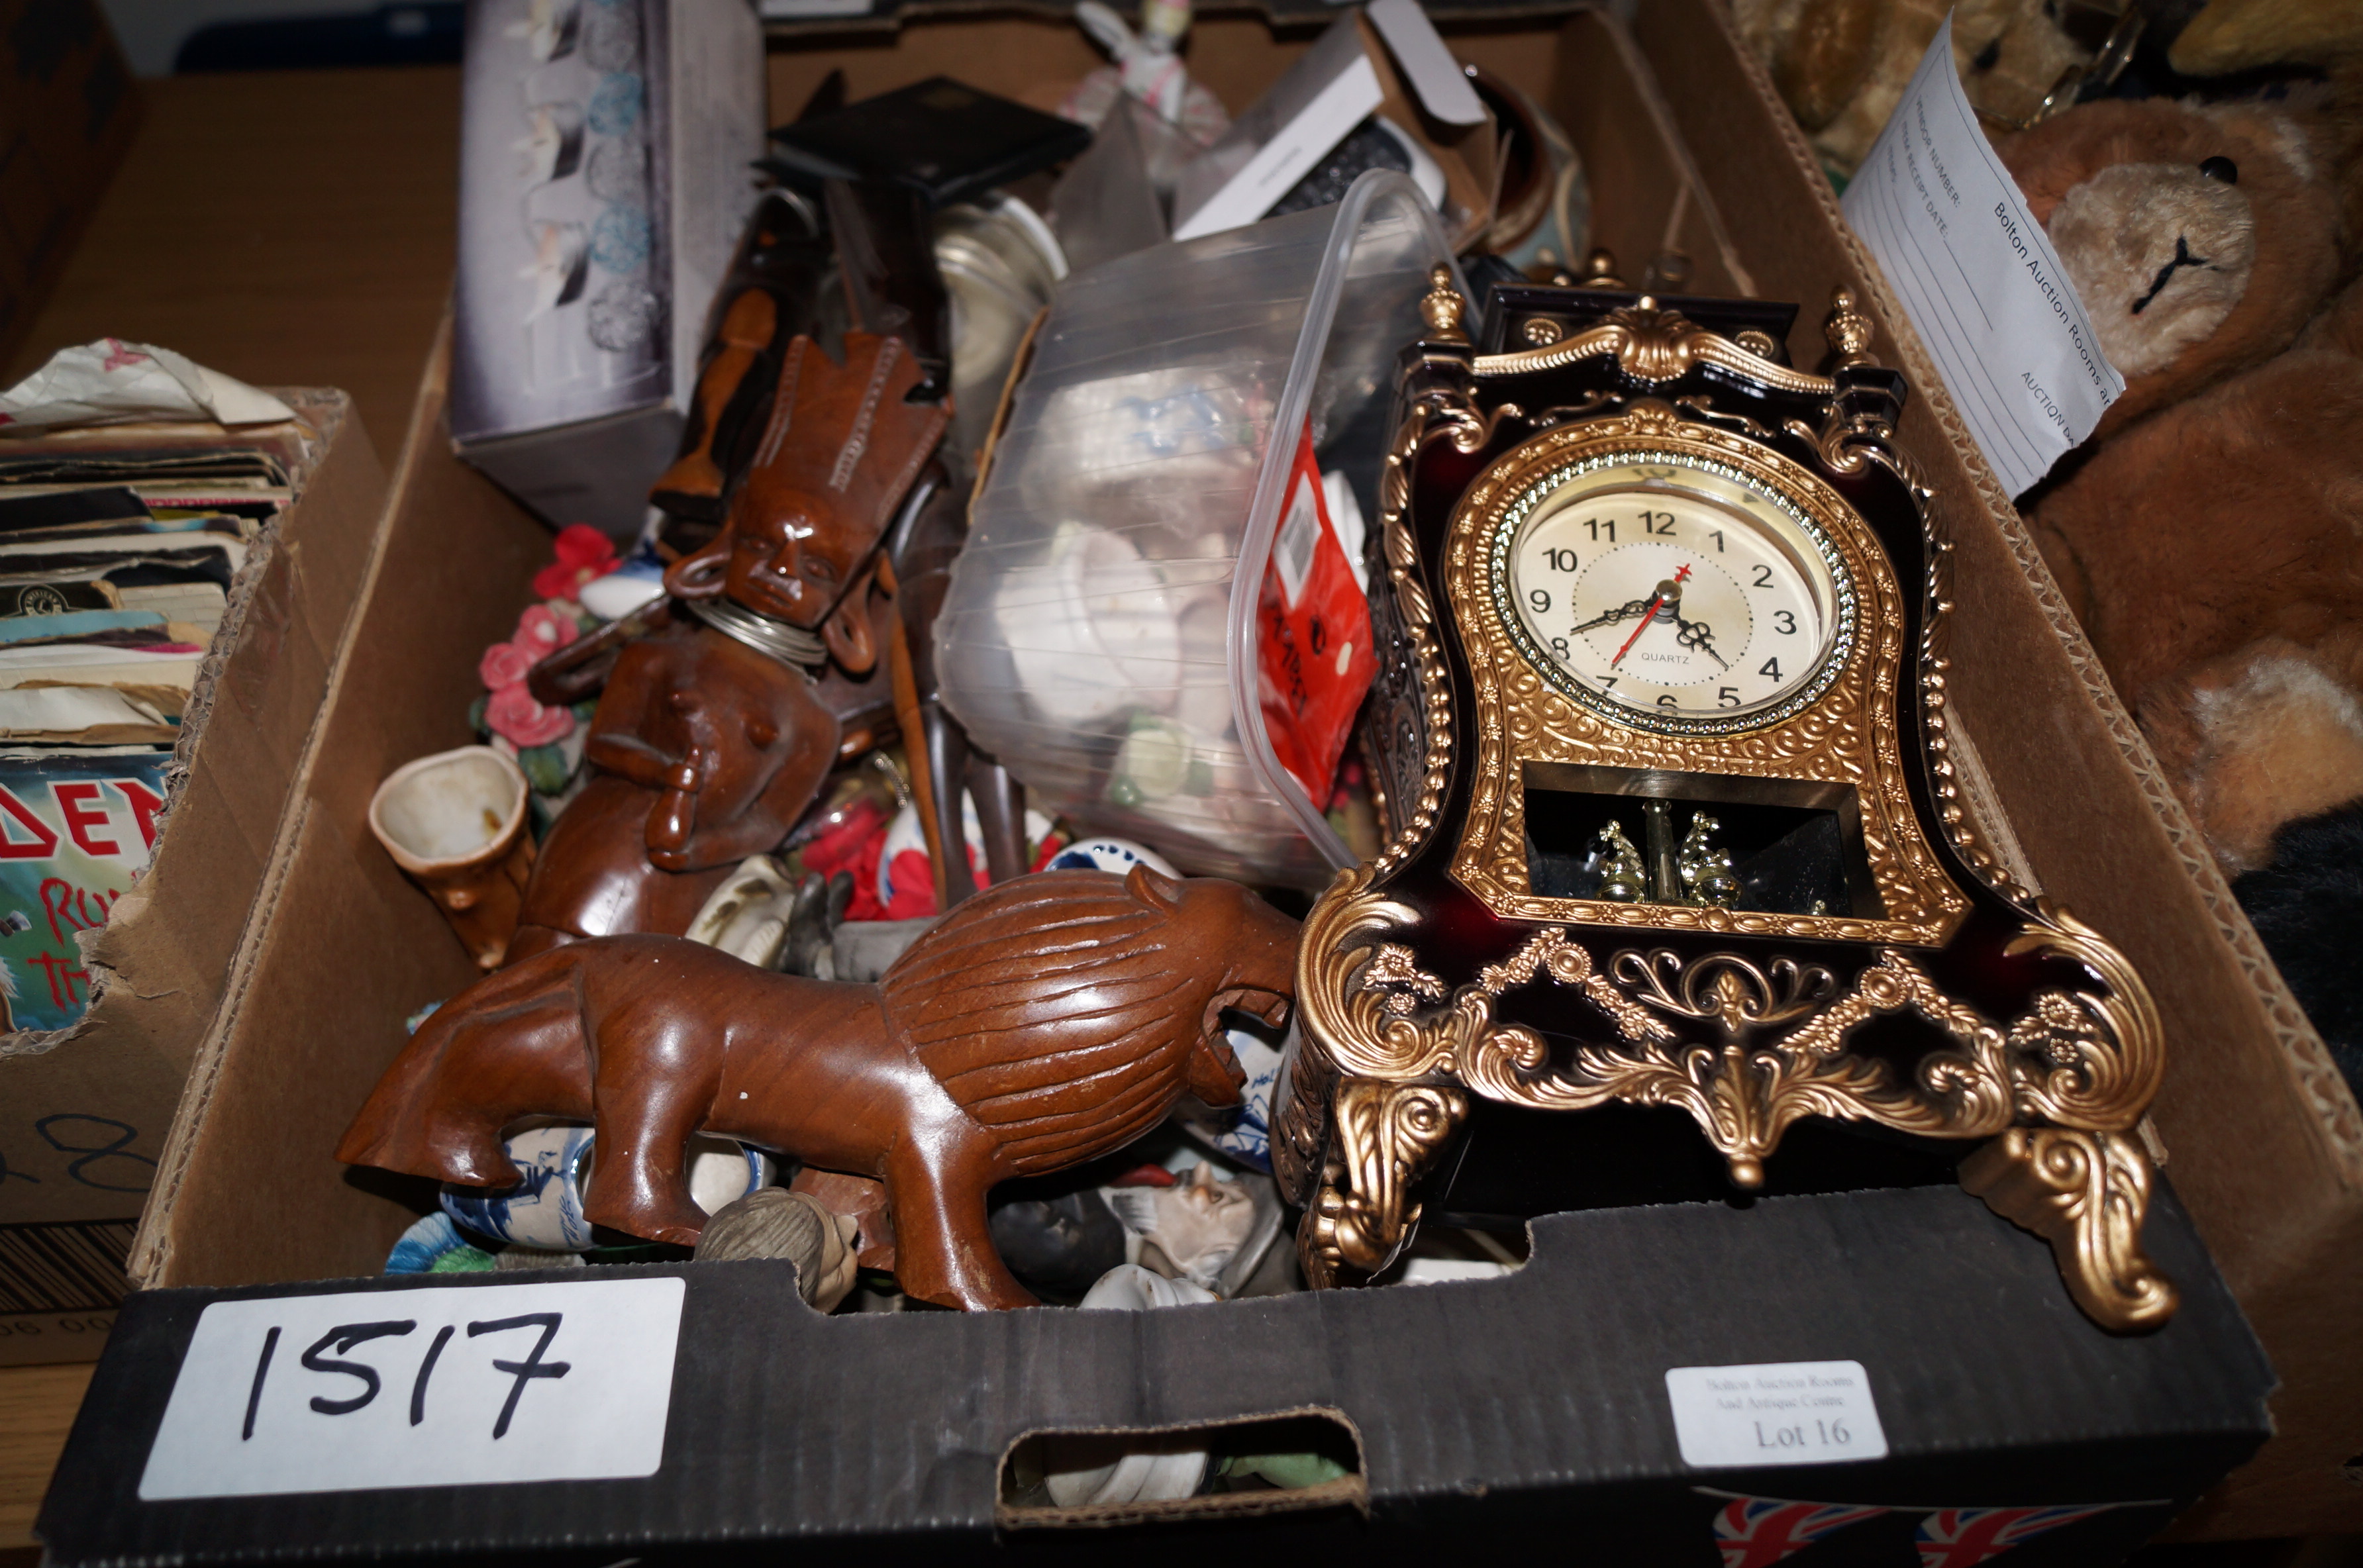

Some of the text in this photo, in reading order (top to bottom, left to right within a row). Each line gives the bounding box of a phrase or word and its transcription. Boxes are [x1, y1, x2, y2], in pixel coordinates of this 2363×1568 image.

[1929, 148, 1960, 208] NUMBER:
[1907, 153, 1929, 200] RECEIPT
[1926, 201, 1948, 238] DATE:
[1994, 202, 2028, 260] Bolton
[2026, 260, 2069, 324] Auction
[2068, 324, 2101, 385] Rooms
[2021, 372, 2065, 426] AUCTION
[1584, 518, 1617, 542] 11
[1638, 511, 1676, 536] 12
[1709, 530, 1725, 553] 1
[1542, 548, 1578, 573] 10
[1752, 565, 1774, 588] 2
[1530, 589, 1551, 613] 9
[1773, 610, 1797, 635] 3
[1552, 637, 1570, 662] 8
[1642, 652, 1689, 665] QUARTZ
[1759, 657, 1784, 683] 4
[1596, 675, 1618, 695] 7
[1717, 687, 1741, 709] 5
[39, 871, 137, 948] RU
[242, 1312, 571, 1441] 1517
[1756, 1377, 1806, 1389] Auction
[1748, 1396, 1798, 1410] Antique
[1754, 1417, 1852, 1447] Lot 16
